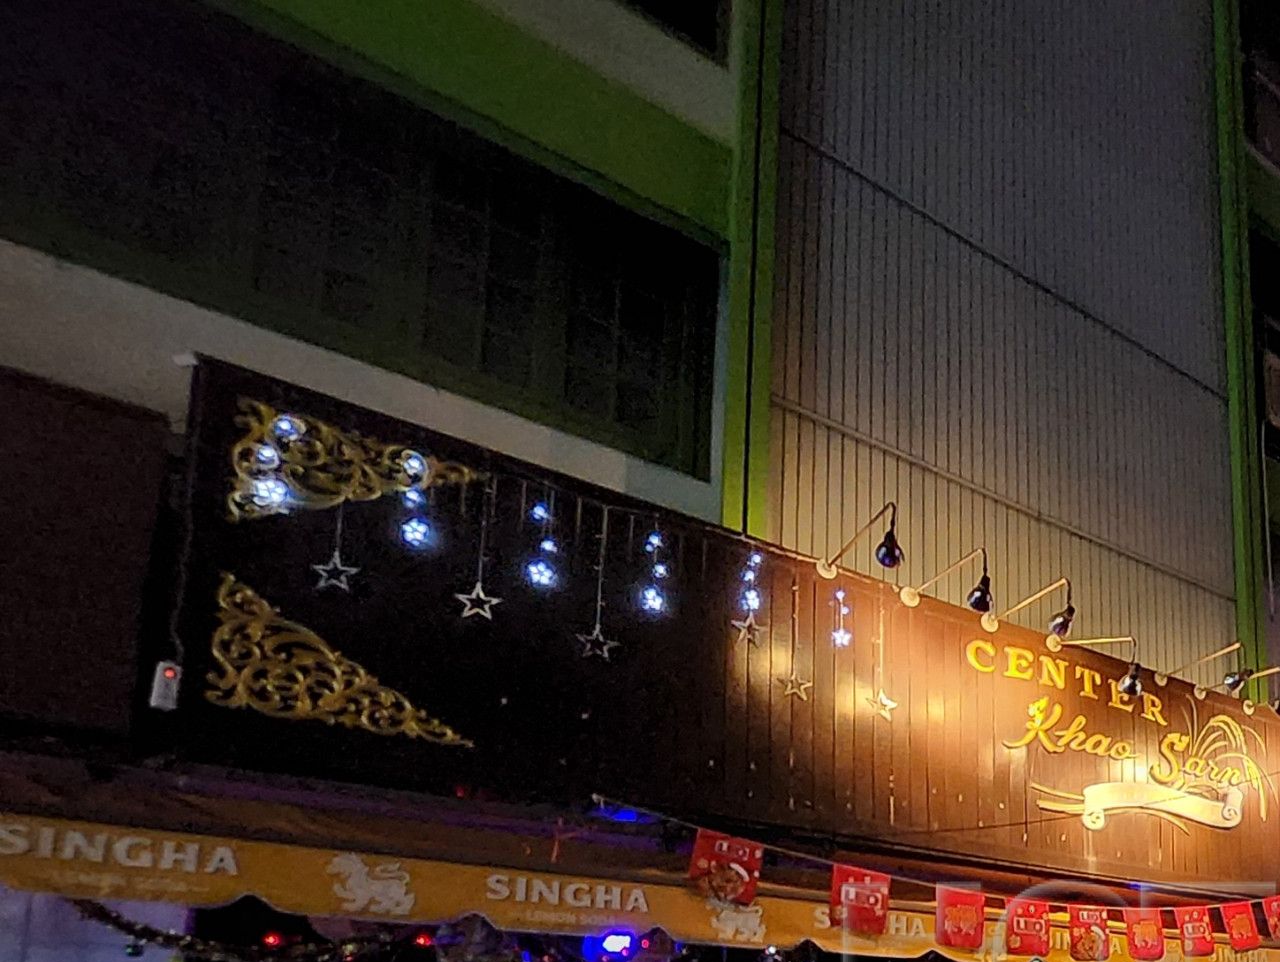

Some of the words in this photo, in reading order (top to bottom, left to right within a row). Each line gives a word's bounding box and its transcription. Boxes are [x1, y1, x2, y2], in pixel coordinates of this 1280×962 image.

[966, 639, 1168, 726] CENTER
[1002, 696, 1141, 760] Khao
[1150, 732, 1243, 790] Sarn
[0, 823, 239, 876] SINGHA
[486, 873, 648, 913] SINGHA
